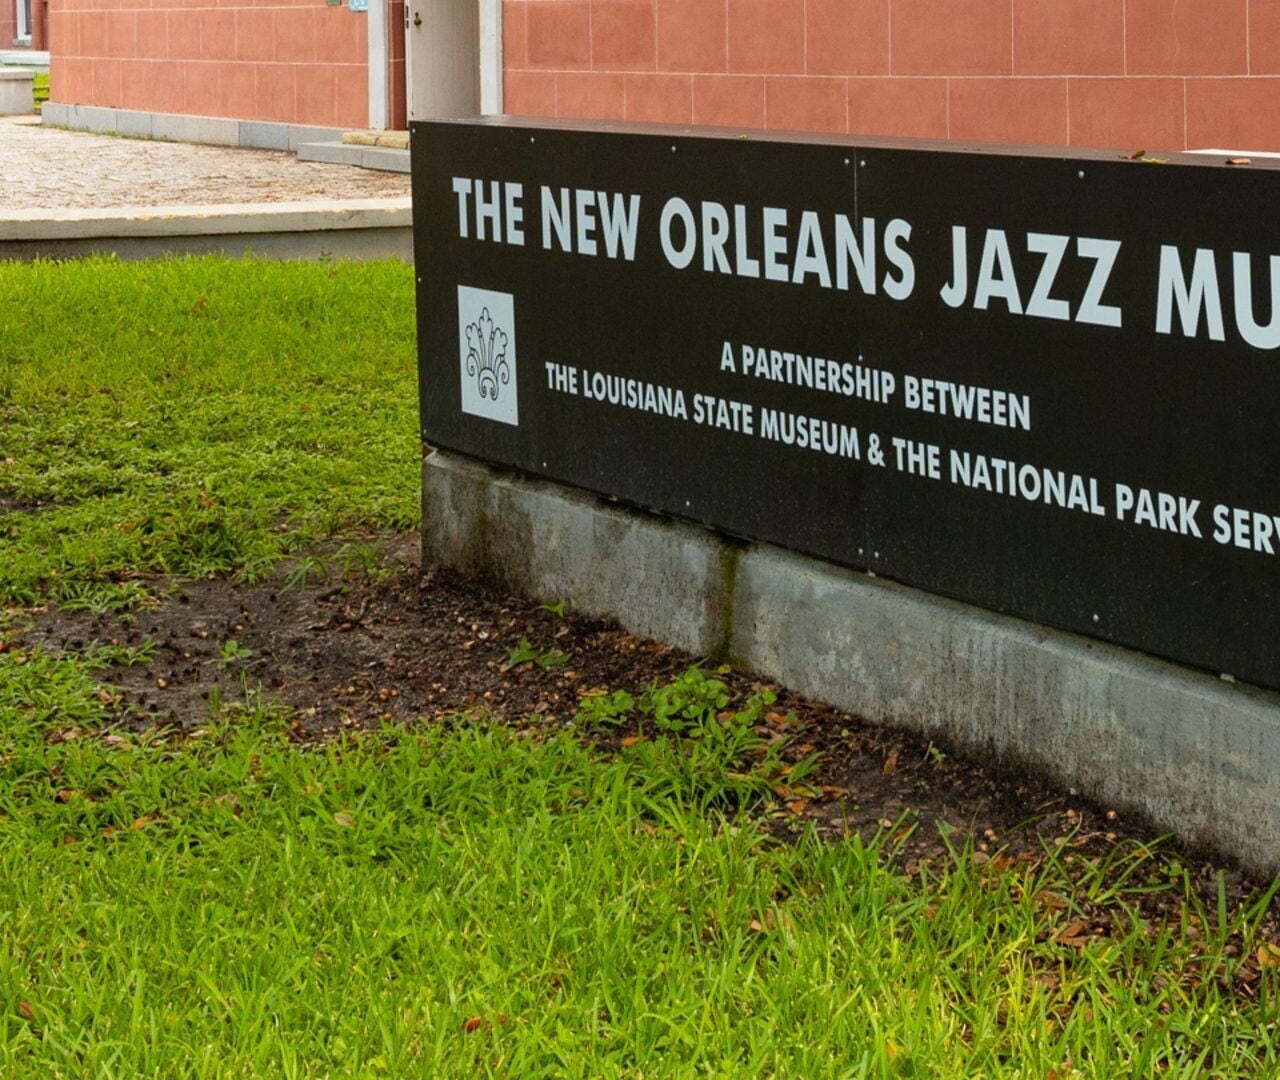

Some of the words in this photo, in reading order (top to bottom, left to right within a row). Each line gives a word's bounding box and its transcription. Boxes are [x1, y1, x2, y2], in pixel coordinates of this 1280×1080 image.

[452, 176, 525, 246] THE
[541, 185, 641, 261] NEW
[660, 196, 916, 301] ORLEANS
[940, 225, 1122, 328] JAZZ
[545, 361, 578, 395] THE
[583, 369, 688, 420] LOUISIANA
[693, 393, 754, 435] STATE
[760, 407, 861, 460] MUSEUM
[867, 432, 887, 467] &
[892, 437, 941, 480] THE
[950, 449, 1106, 516] NATIONAL
[1115, 483, 1203, 539] PARK
[720, 341, 736, 373] A
[742, 344, 896, 404] PARTNERSHIP
[904, 374, 1031, 431] BETWEEN
